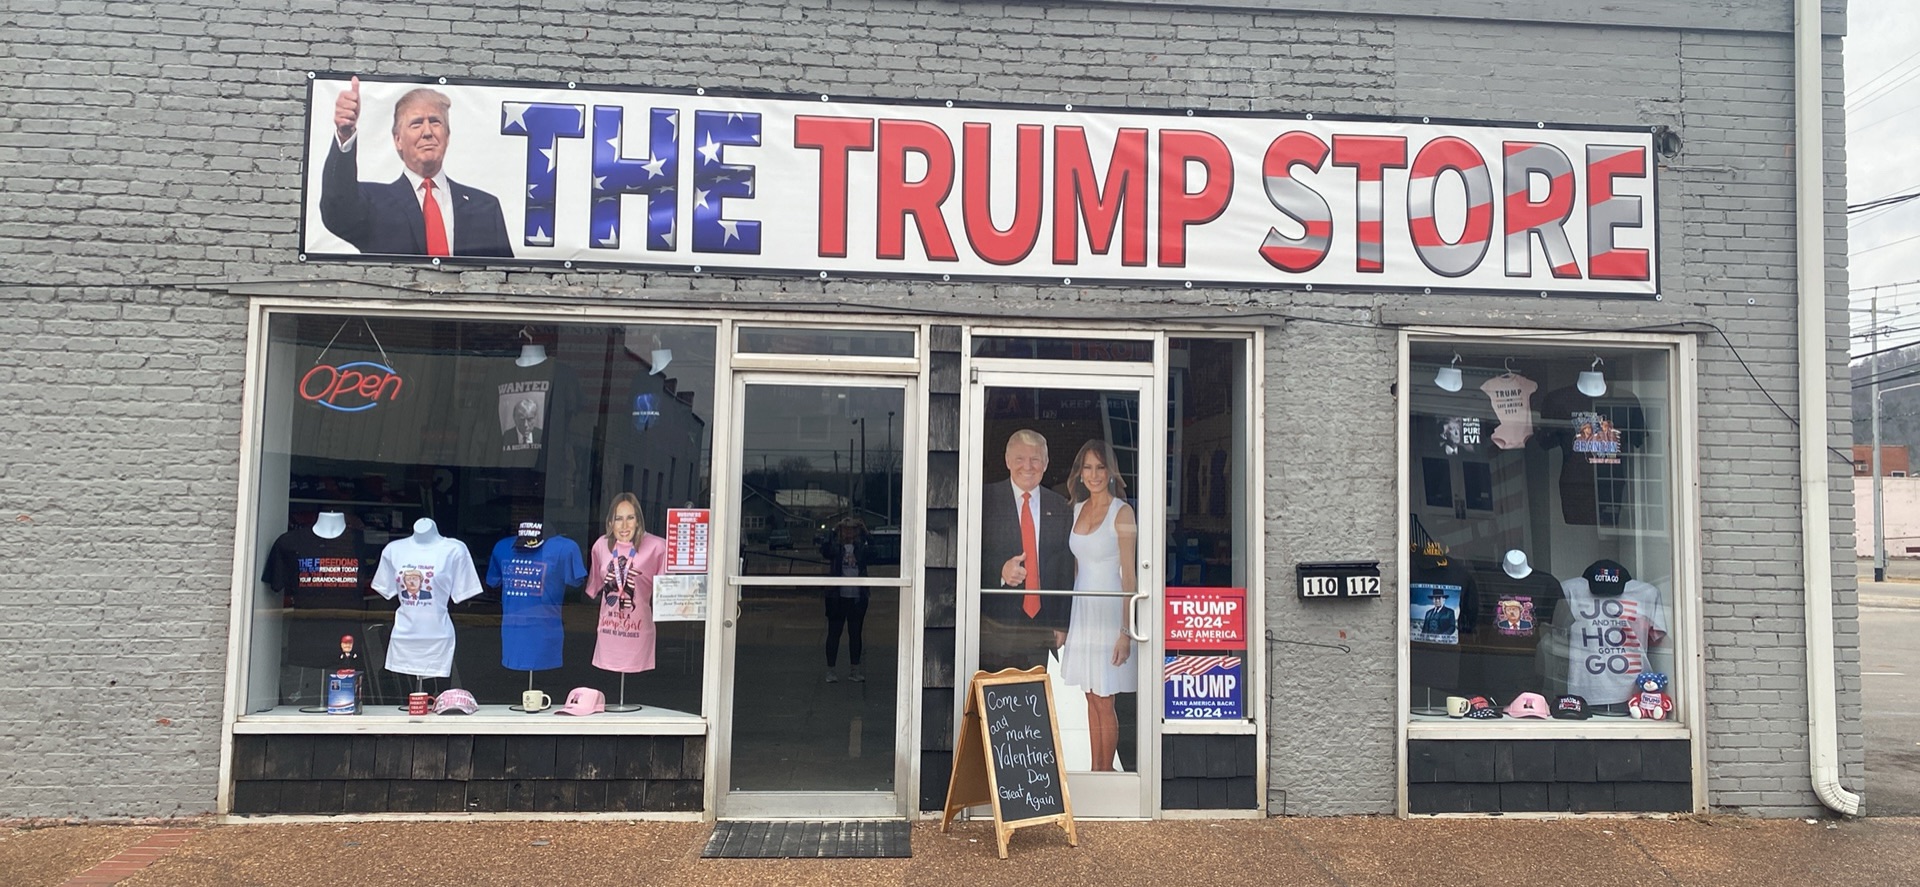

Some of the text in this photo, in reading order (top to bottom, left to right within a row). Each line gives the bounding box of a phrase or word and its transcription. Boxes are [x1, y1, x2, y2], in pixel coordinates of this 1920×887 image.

[500, 101, 1651, 282] THE TRUMP STORE
[299, 364, 403, 404] Open
[498, 381, 550, 395] WANTED
[1495, 389, 1522, 398] TRUMP
[1060, 399, 1092, 409] KEEP
[1463, 435, 1480, 444] EVI
[1573, 440, 1618, 452] BRANDON
[298, 558, 359, 568] THE FREEDOMS
[515, 566, 541, 576] NAVY
[1595, 574, 1620, 583] GOTTA GO
[1307, 578, 1337, 595] 110
[1350, 577, 1379, 594] 112
[1169, 601, 1238, 616] TRUMP
[1611, 619, 1627, 627] THE
[1170, 630, 1237, 639] SAVE AMERICA
[1598, 647, 1627, 655] GOTTA
[1169, 674, 1237, 698] TRUMP
[987, 690, 1042, 718] Come in
[1184, 707, 1223, 718] 2024
[990, 714, 1009, 736] and
[1006, 724, 1043, 742] make
[993, 742, 1056, 770] Valentine's
[1026, 768, 1051, 789] Day
[998, 783, 1025, 801] Great
[1025, 791, 1056, 812] Again
